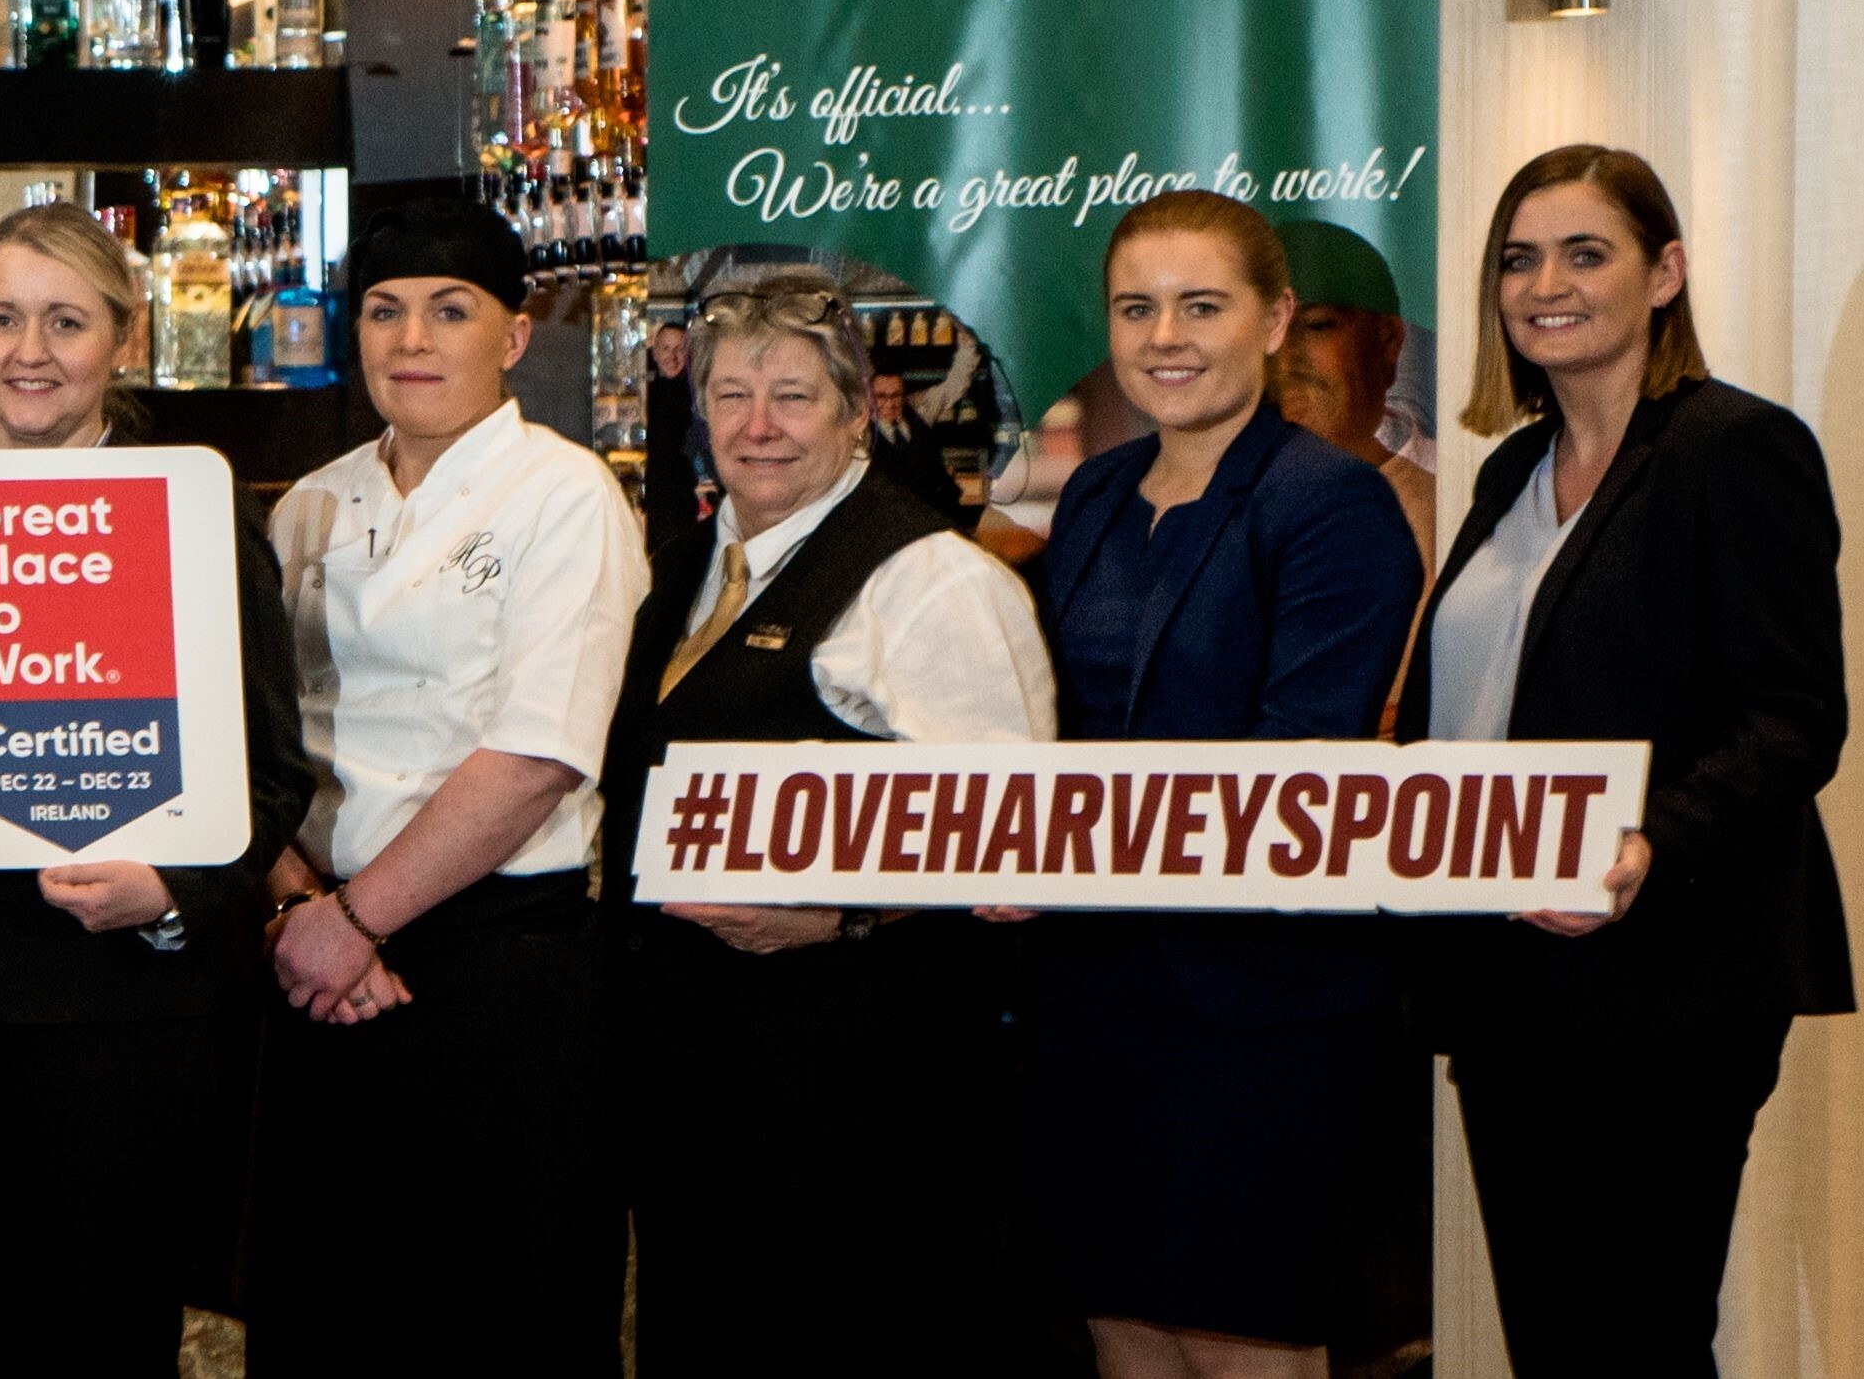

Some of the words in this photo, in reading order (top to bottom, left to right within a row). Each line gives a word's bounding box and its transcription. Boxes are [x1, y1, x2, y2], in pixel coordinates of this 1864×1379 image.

[674, 54, 797, 134] It's
[810, 62, 1011, 145] official....
[726, 147, 902, 223] We're
[913, 177, 944, 209] a
[947, 156, 1077, 233] great
[1211, 151, 1260, 203] to
[1270, 146, 1426, 202] work!
[29, 803, 112, 822] IRELAND
[32, 773, 57, 791] 22
[79, 772, 123, 790] DEC
[127, 772, 152, 789] 23
[666, 771, 1609, 880] #LOVEHARVEYSPOINT
